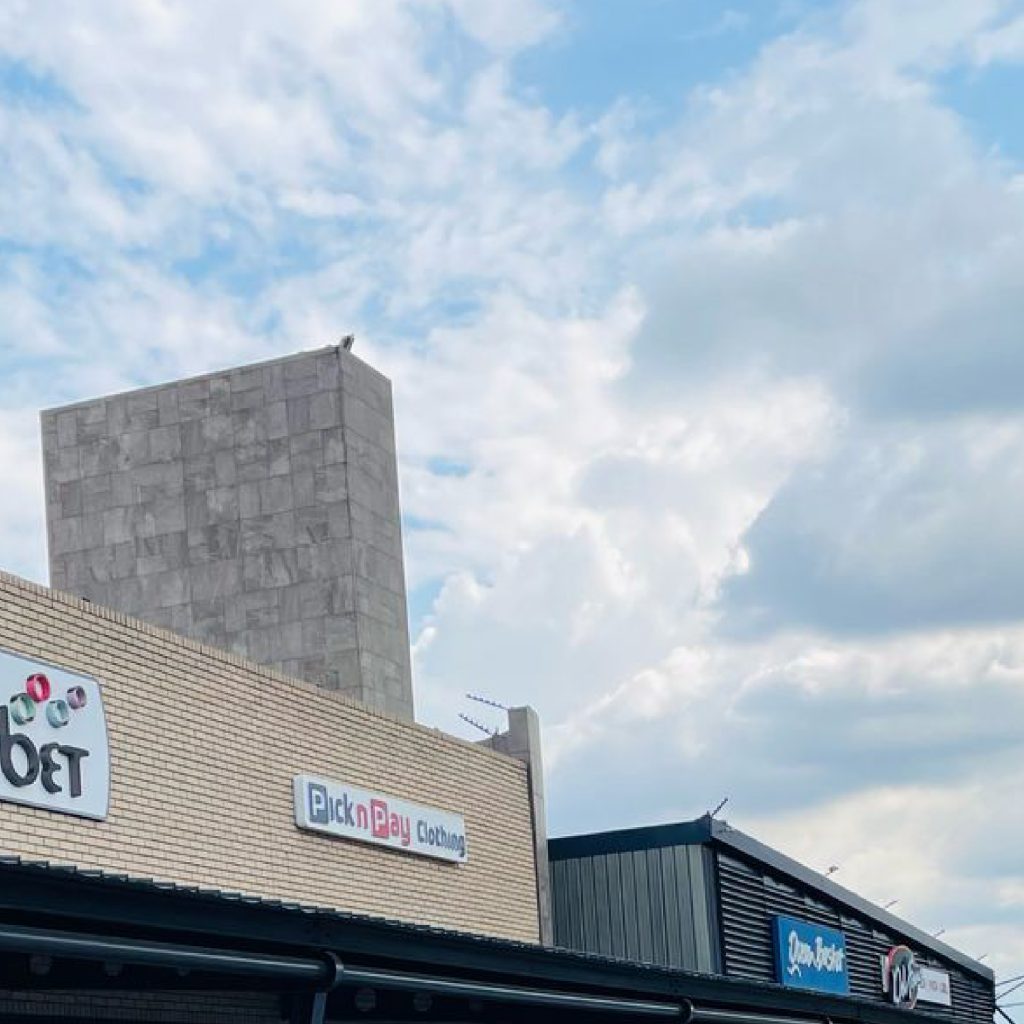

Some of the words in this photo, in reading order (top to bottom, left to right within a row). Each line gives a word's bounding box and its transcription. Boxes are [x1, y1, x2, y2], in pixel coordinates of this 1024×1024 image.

[308, 777, 355, 828] Pick
[356, 803, 369, 830] n
[370, 798, 411, 847] Pay
[416, 819, 466, 858] Clothing
